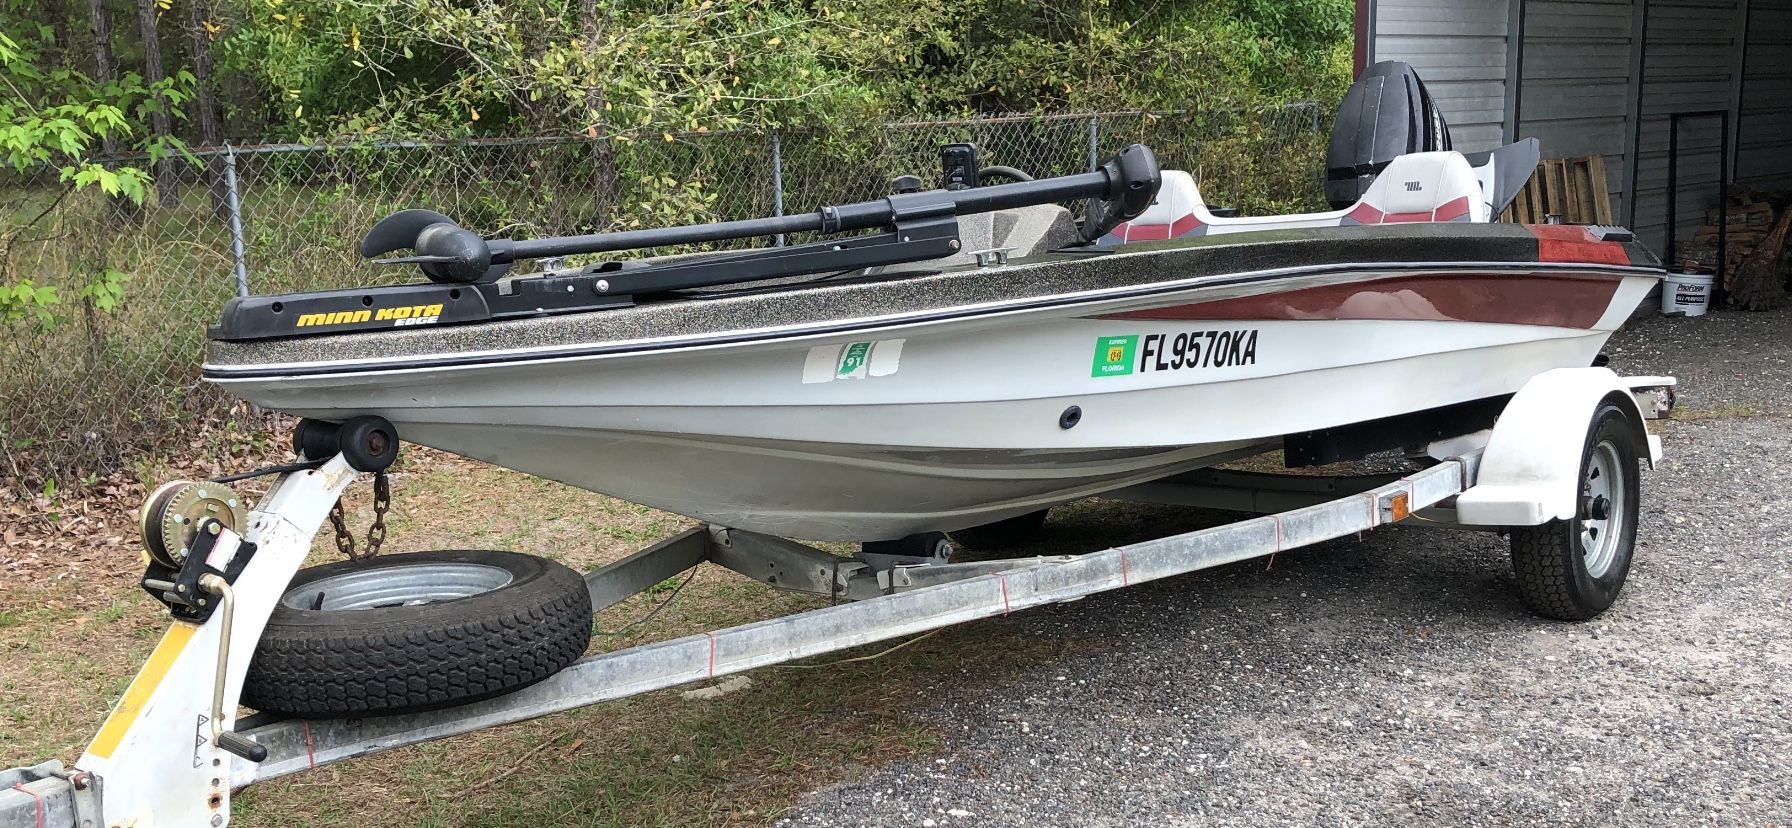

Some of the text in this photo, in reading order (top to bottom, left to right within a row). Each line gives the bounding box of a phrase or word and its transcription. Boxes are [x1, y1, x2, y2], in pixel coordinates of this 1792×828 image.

[296, 304, 444, 326] MINN KOTA
[394, 316, 439, 327] EDGE
[1140, 330, 1258, 372] FL9570KA
[847, 357, 861, 367] 91
